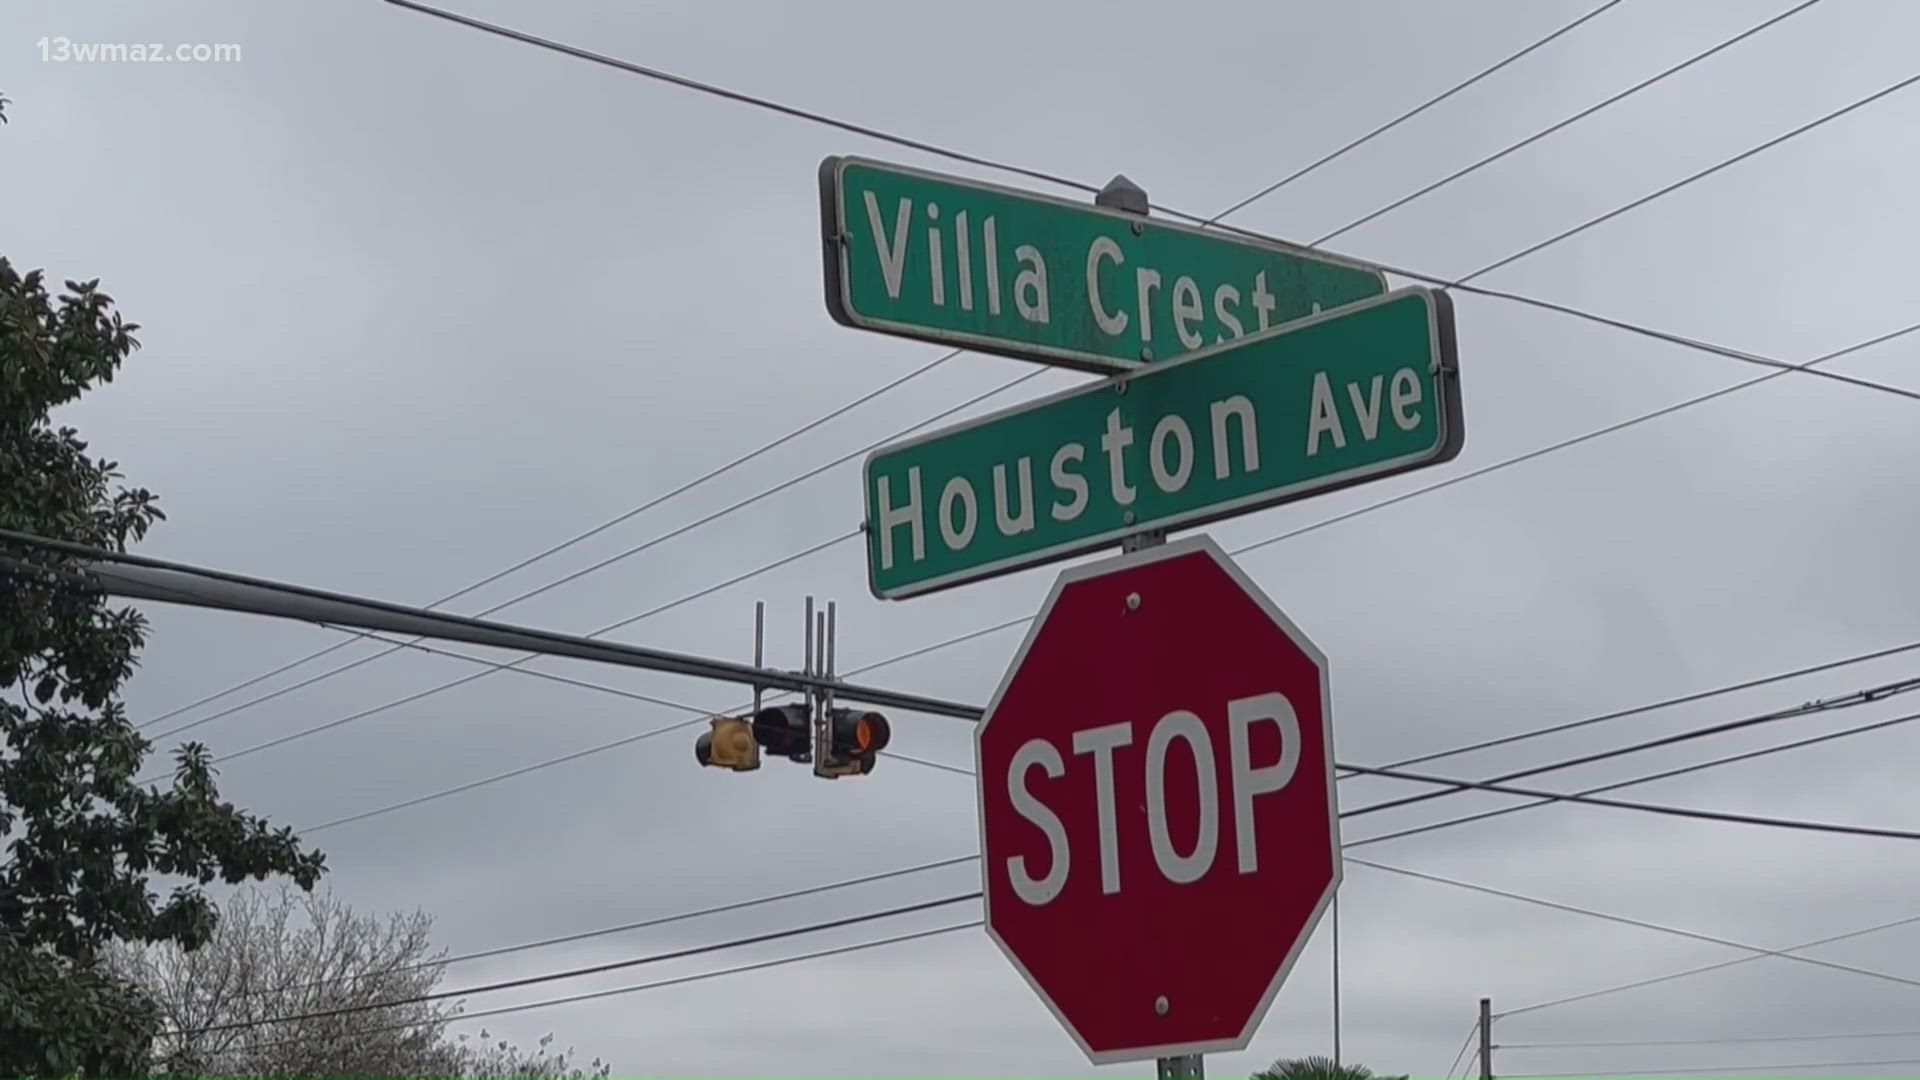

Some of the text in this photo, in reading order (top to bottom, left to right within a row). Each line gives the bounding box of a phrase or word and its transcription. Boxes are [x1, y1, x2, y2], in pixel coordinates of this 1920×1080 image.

[863, 189, 1276, 350] Villa Crest
[876, 366, 1423, 571] Houston Ave
[1006, 691, 1302, 906] STOP
